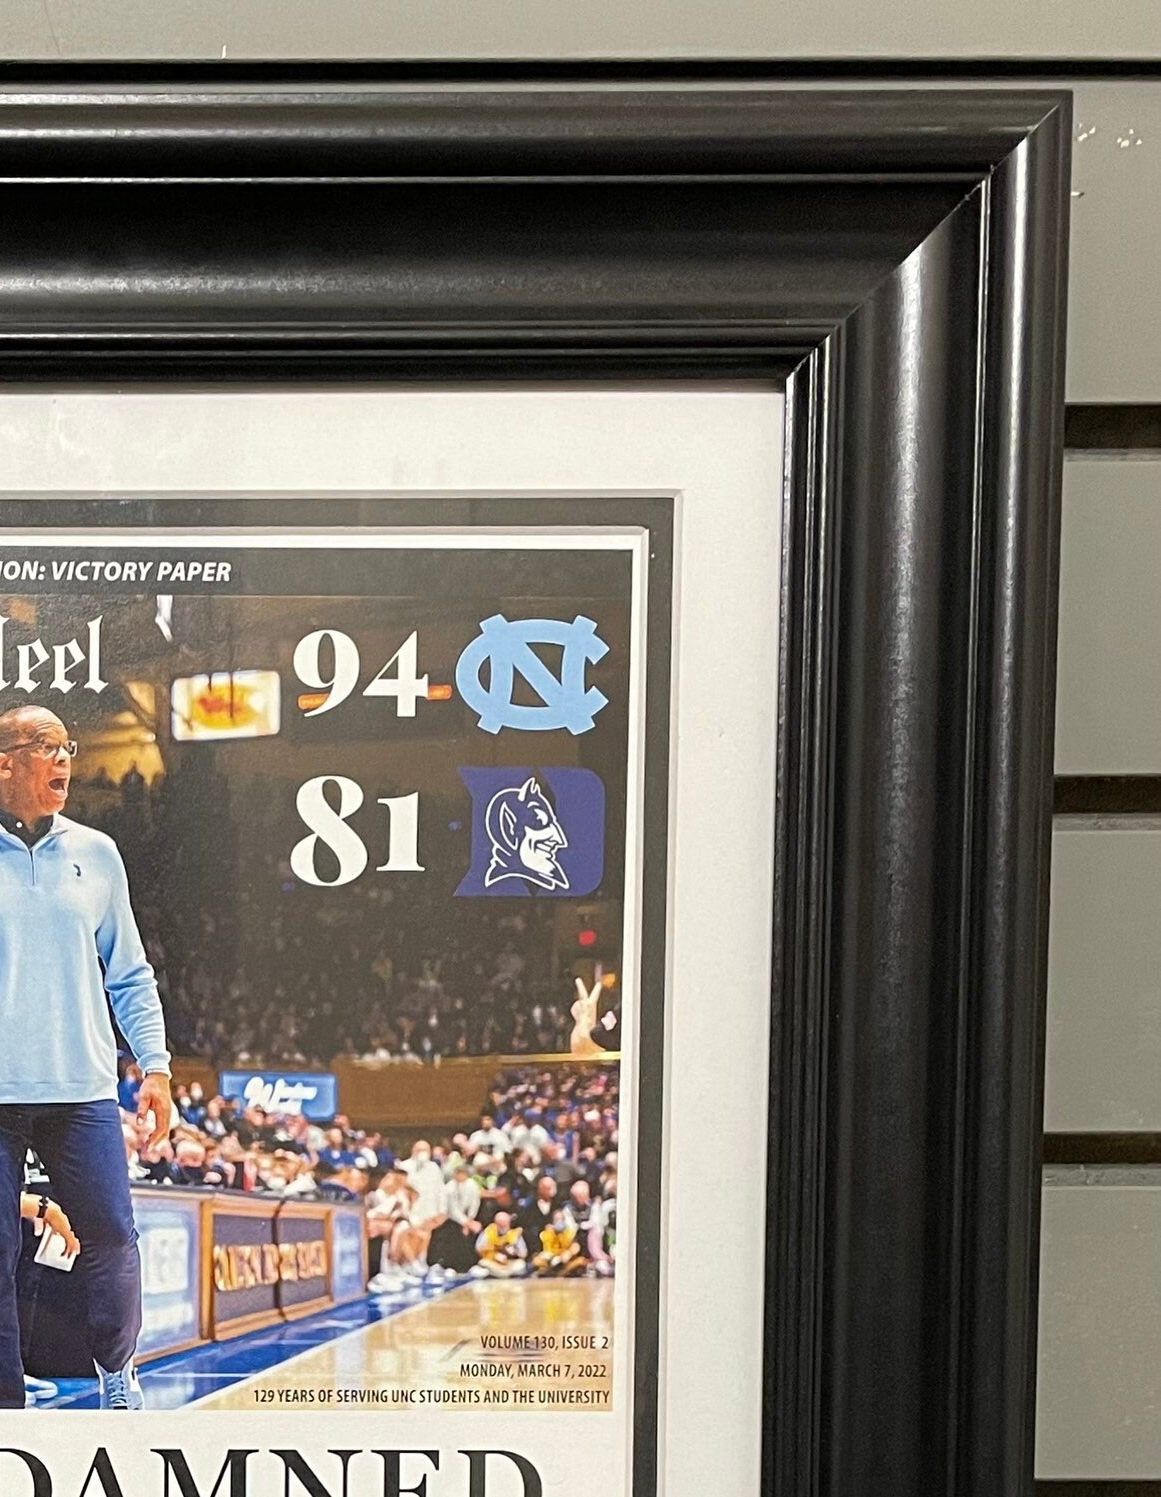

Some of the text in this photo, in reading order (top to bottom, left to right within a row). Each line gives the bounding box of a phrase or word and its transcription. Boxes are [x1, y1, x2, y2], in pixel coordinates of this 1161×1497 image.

[52, 561, 153, 581] VICTORY
[157, 562, 231, 581] PAPER
[293, 629, 428, 717] 94
[291, 776, 424, 886] 81
[480, 1336, 609, 1351] VOLUME 130, ISSUE 2
[460, 1364, 607, 1379] MONDAY, MARCH 7, 2022
[254, 1389, 611, 1404] 129 YEARS OF SERVING UNC STUDENTS AND THE UNIVERSITY
